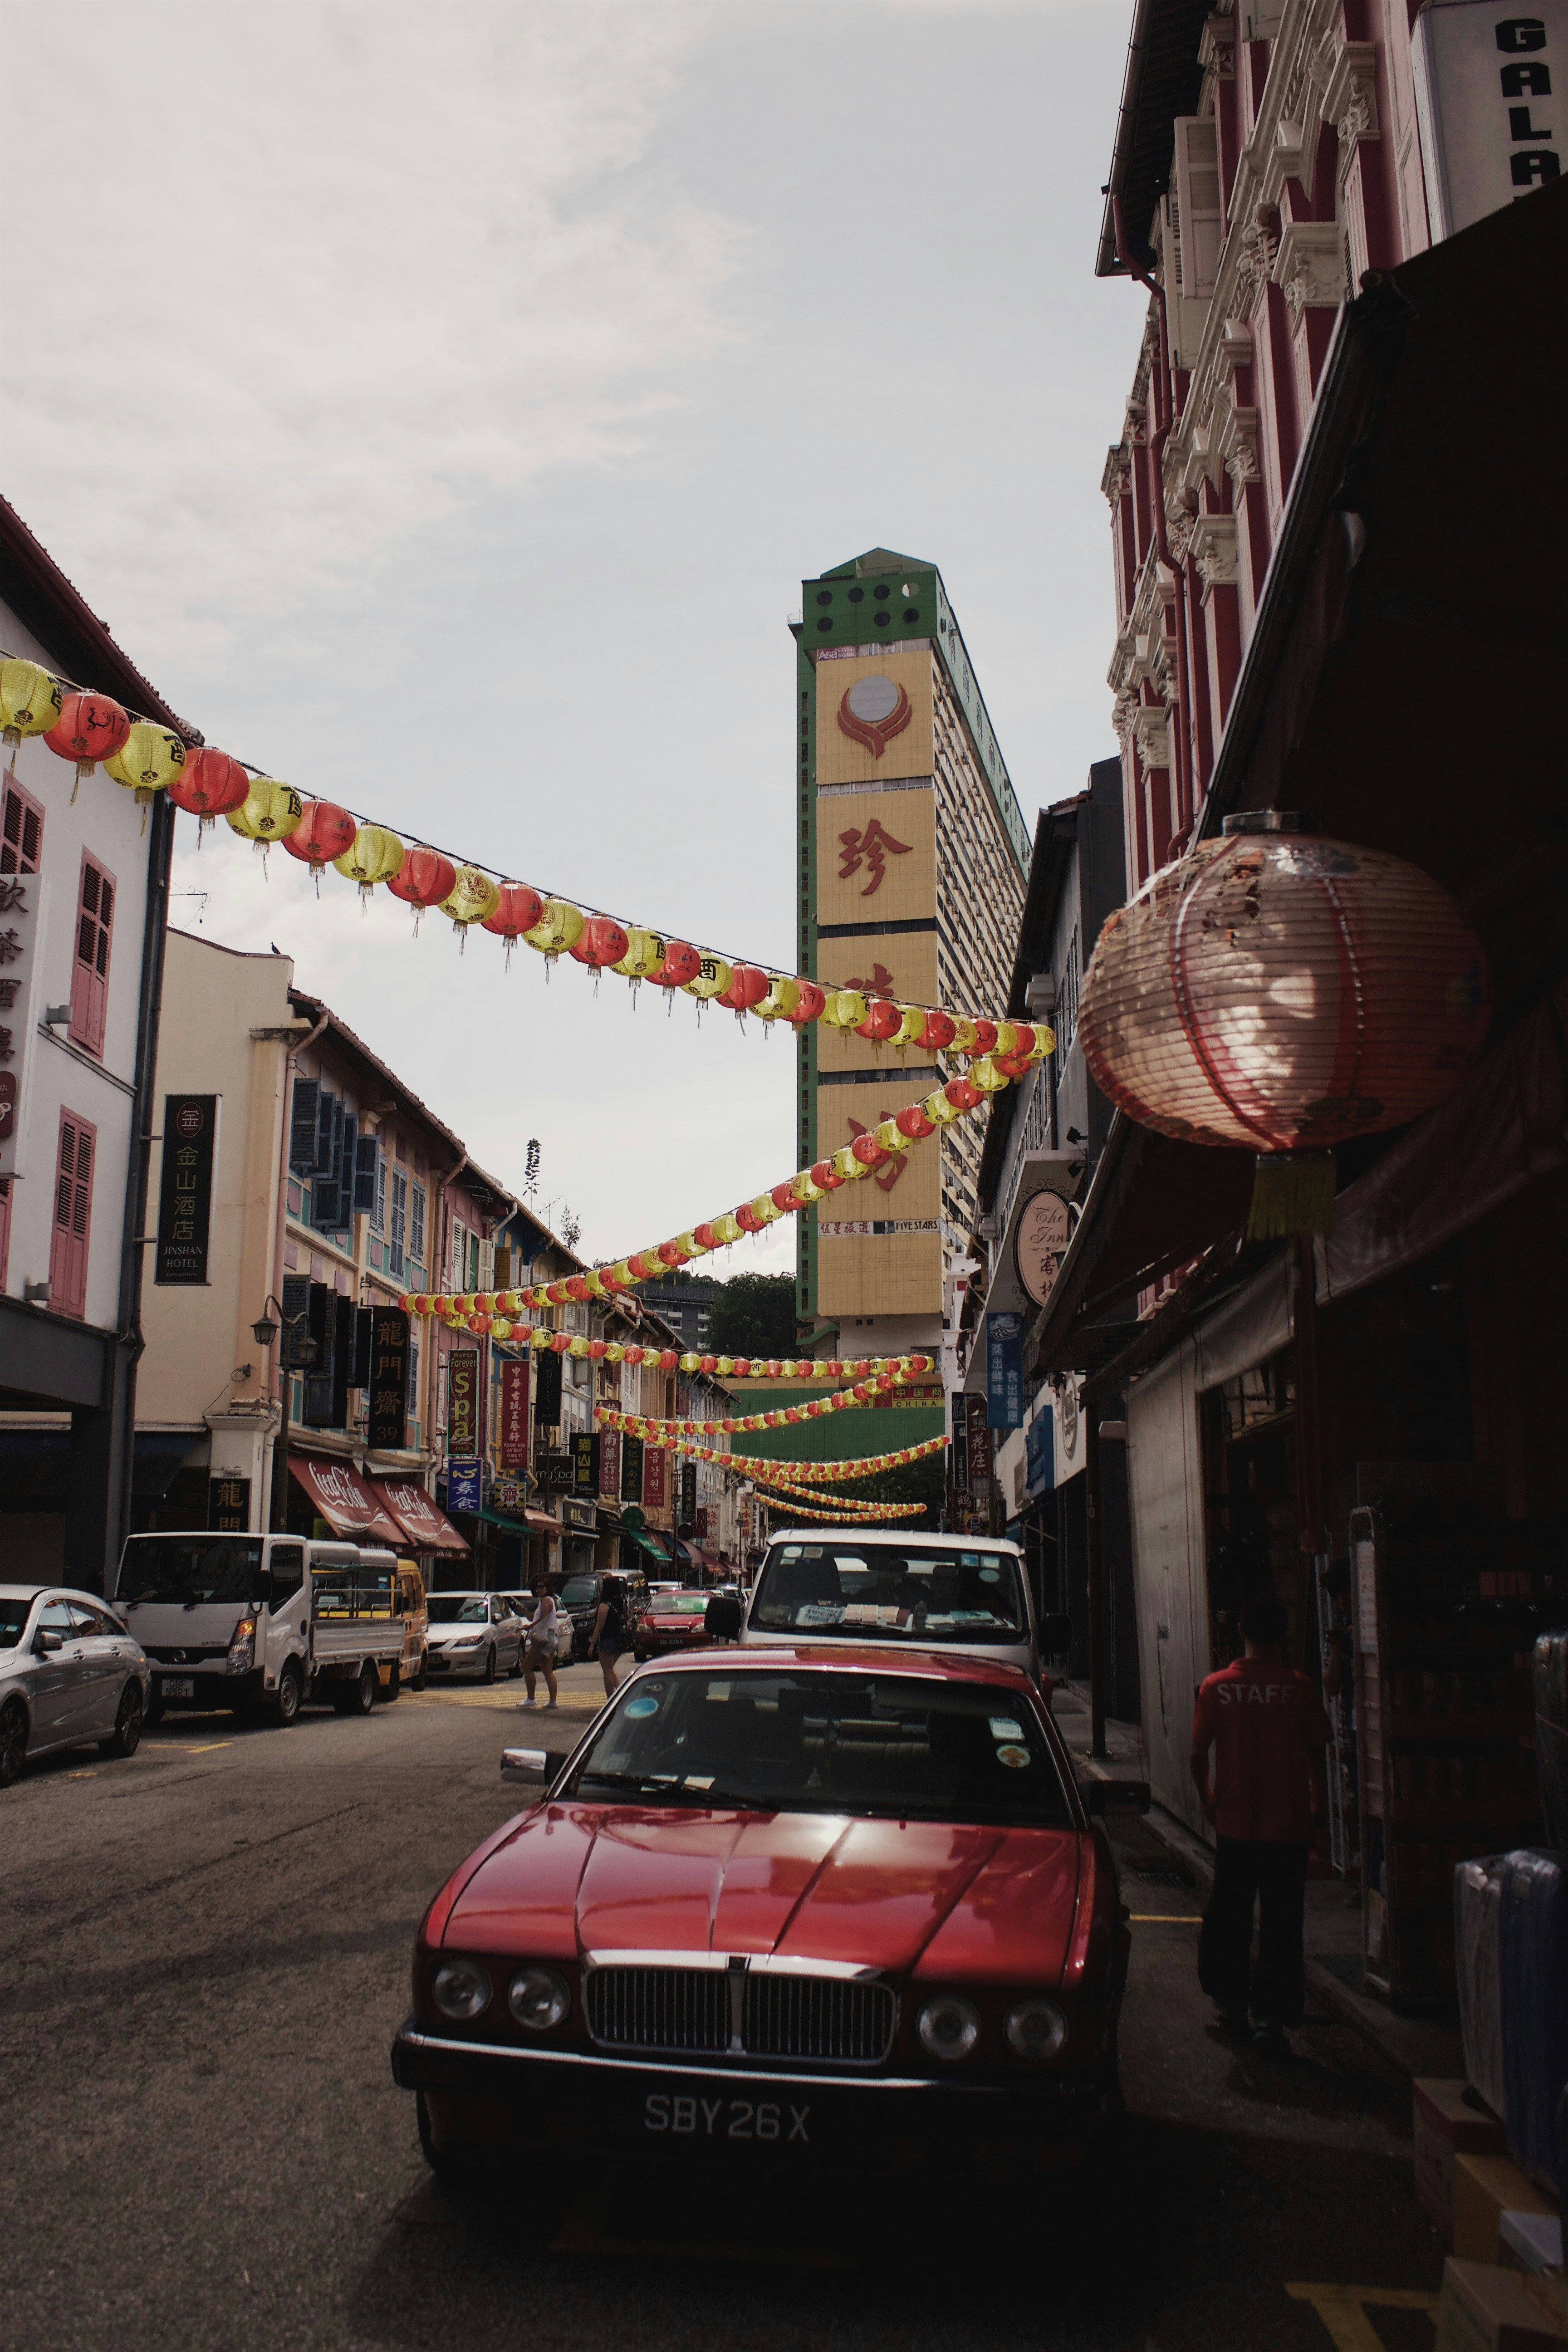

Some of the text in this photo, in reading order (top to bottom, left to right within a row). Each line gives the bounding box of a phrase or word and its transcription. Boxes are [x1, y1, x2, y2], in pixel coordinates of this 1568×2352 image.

[172, 1146, 199, 1240] 金山酒店
[1030, 1206, 1064, 1224] The
[896, 1220, 938, 1231] FIVE STARS
[1030, 1226, 1064, 1243] Inn
[163, 1246, 202, 1255] JINSHAN
[167, 1258, 198, 1268] HOTEL
[451, 1358, 476, 1367] Forever
[376, 1426, 397, 1442] 39
[649, 1452, 660, 1491] 금강원
[1217, 1683, 1296, 1705] STAFF
